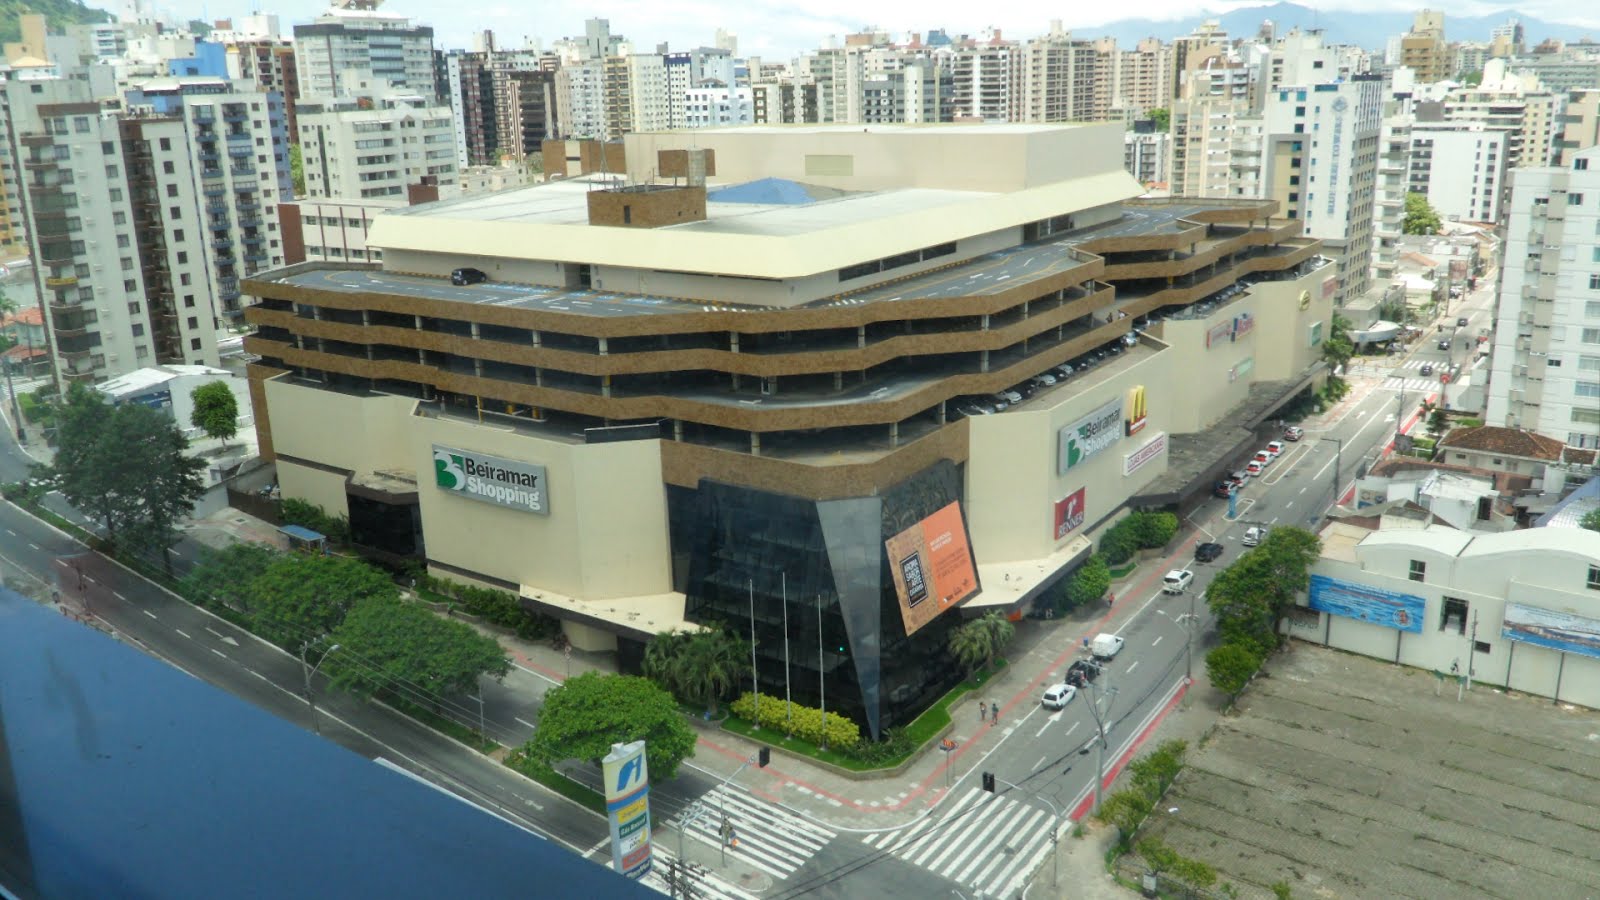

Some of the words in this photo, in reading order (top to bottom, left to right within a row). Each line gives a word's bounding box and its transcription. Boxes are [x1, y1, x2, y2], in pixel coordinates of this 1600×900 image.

[1086, 408, 1121, 437] Beiramar
[1086, 424, 1120, 456] Shopping
[465, 457, 538, 488] Beiramar
[467, 476, 541, 511] Shopping
[1058, 511, 1084, 537] RENNER
